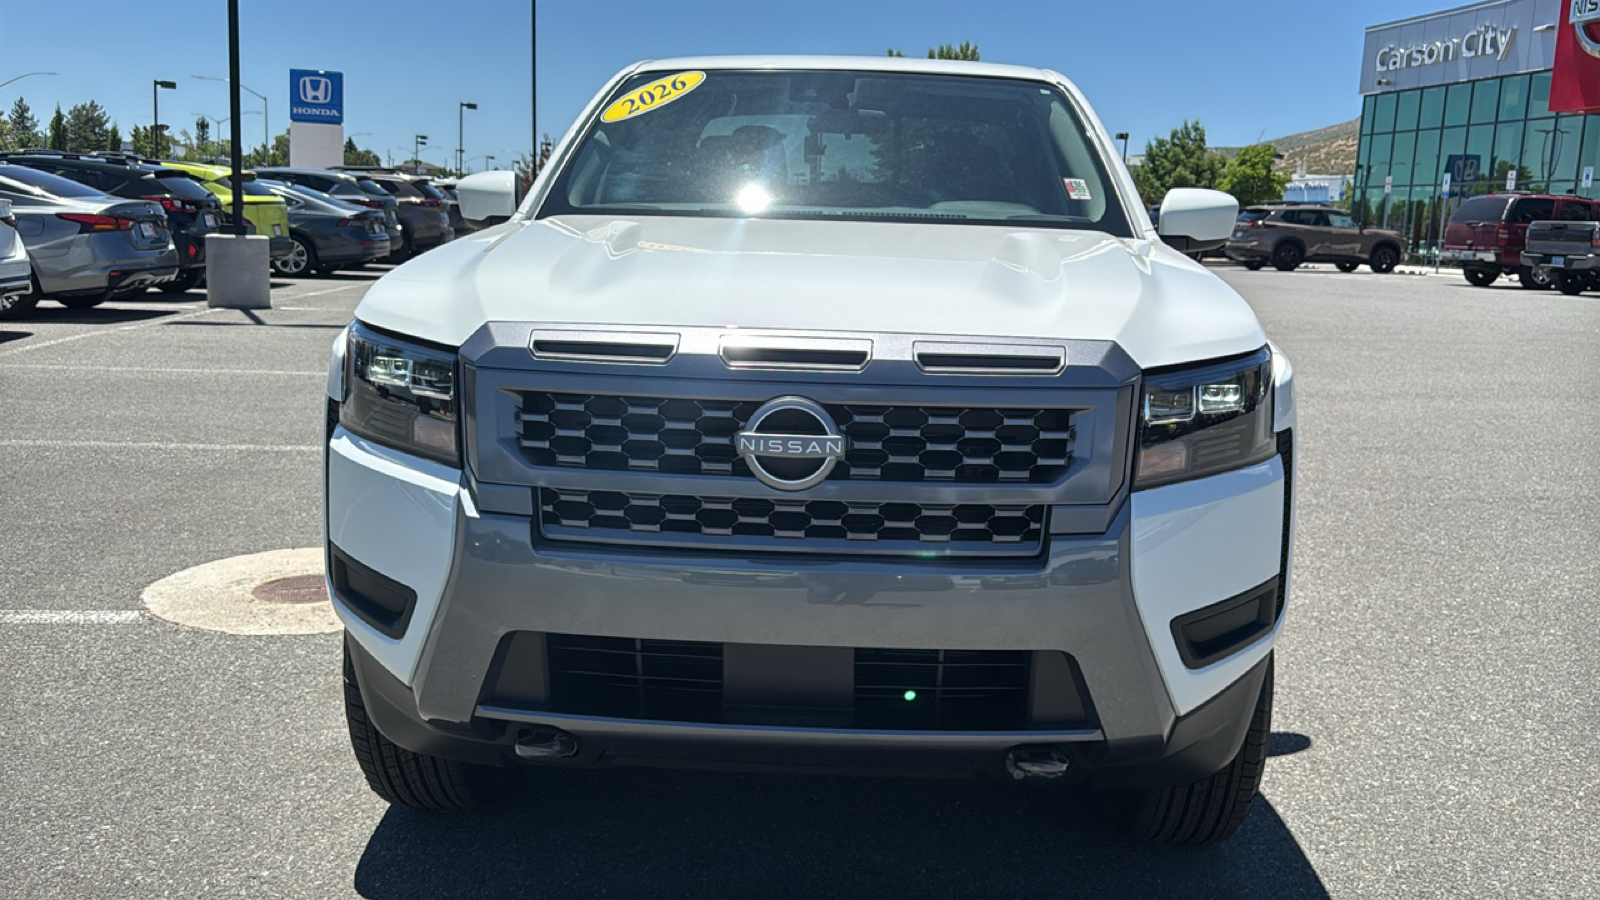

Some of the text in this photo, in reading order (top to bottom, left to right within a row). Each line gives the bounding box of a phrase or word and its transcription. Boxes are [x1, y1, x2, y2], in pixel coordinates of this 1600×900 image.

[1375, 24, 1517, 72] Carson City
[621, 75, 687, 115] 2026
[293, 106, 340, 116] HONDA
[740, 438, 842, 454] NISSAN
